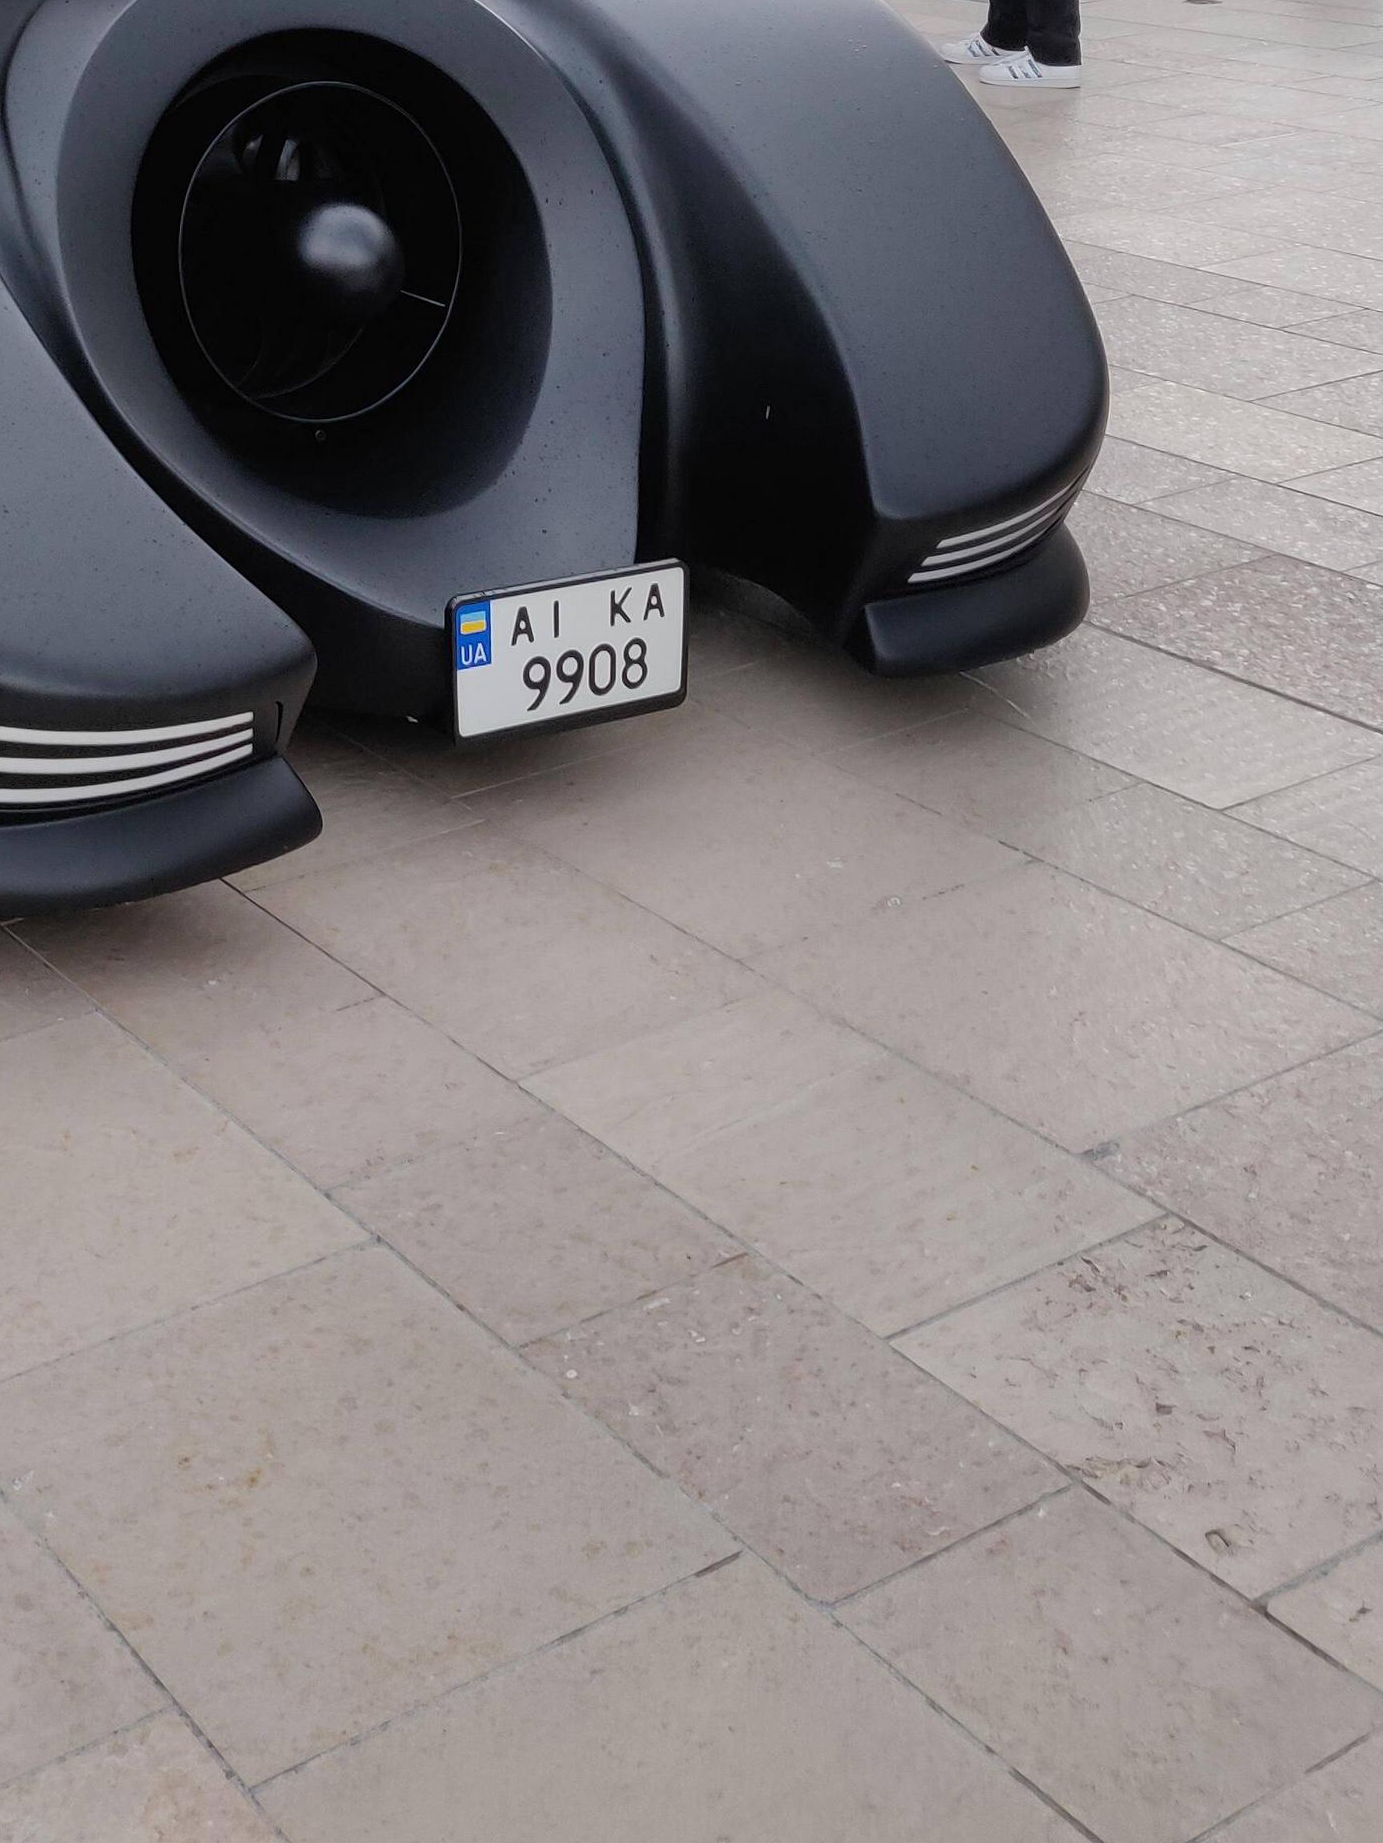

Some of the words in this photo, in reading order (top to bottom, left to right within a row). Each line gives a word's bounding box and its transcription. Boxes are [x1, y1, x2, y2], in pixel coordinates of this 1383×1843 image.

[511, 600, 560, 646] AI
[610, 582, 665, 627] KA
[461, 642, 487, 665] UA
[523, 637, 648, 712] 9908
